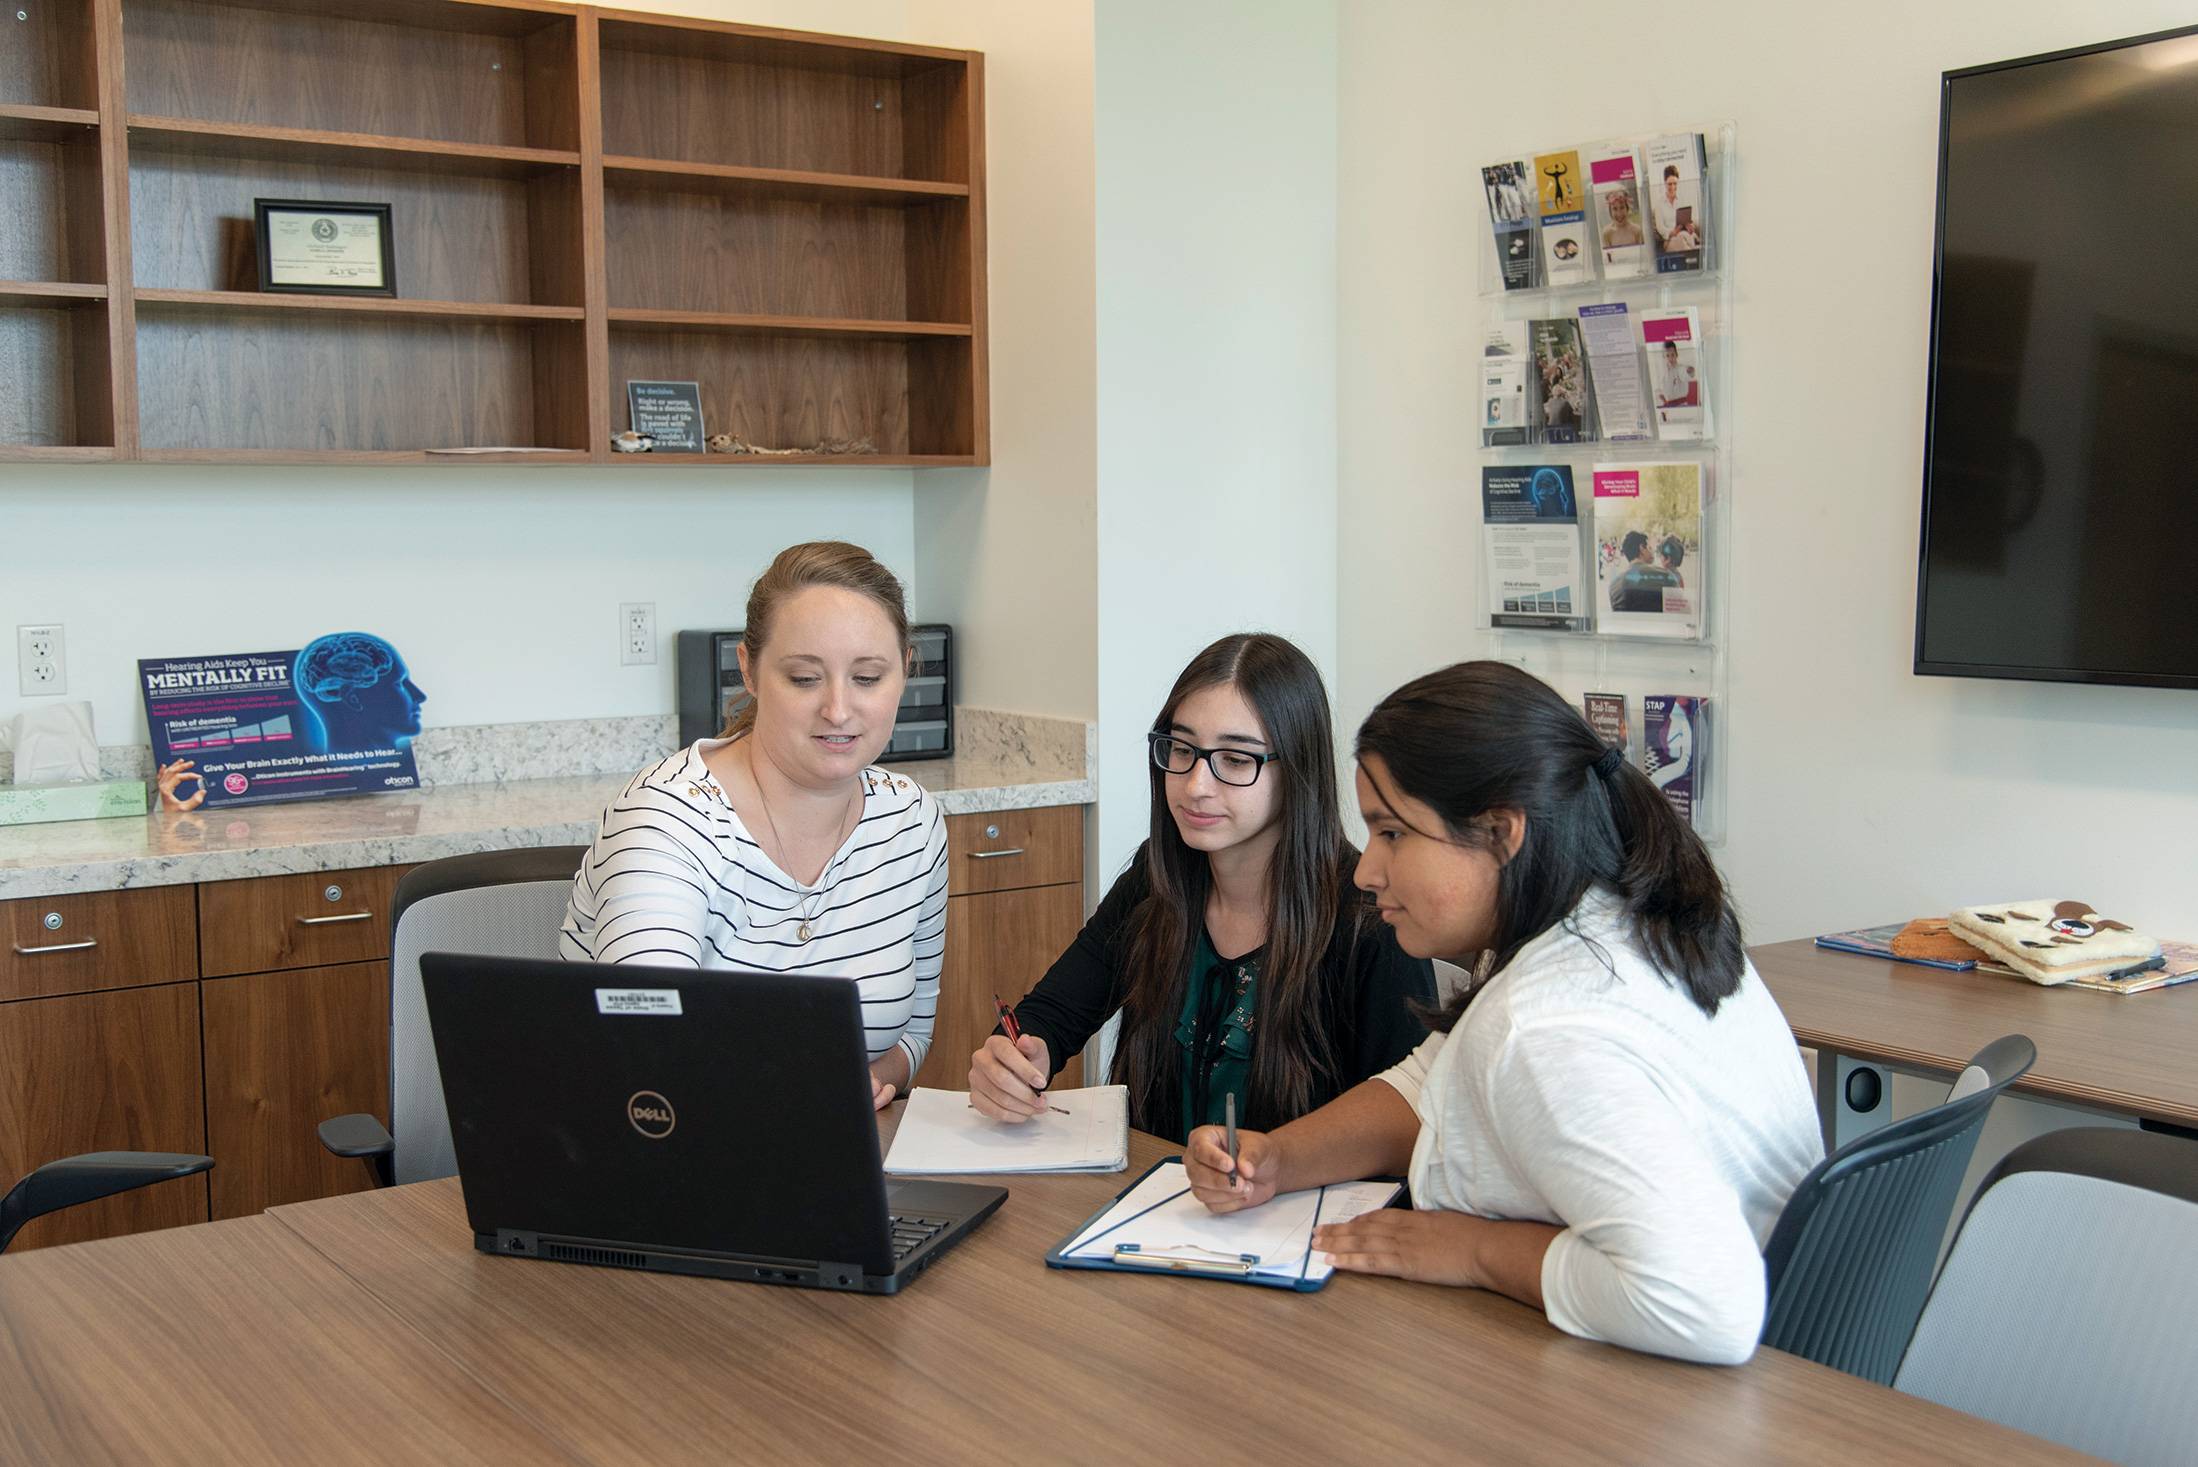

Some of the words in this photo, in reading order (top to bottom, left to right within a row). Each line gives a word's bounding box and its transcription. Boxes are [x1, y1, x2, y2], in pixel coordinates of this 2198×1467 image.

[165, 662, 203, 672] Hearing
[204, 660, 224, 669] Aids
[225, 658, 249, 669] Keep
[249, 657, 267, 666] You
[146, 668, 252, 689] MENTALLY
[255, 665, 287, 681] FIT
[1646, 701, 1665, 710] STAP
[170, 720, 188, 728] Risk
[188, 719, 197, 727] of
[198, 716, 237, 726] dementia
[203, 764, 224, 772] Give
[224, 762, 245, 770] Your
[246, 759, 271, 769] Brain
[271, 756, 304, 766] Exactly
[304, 754, 328, 763] What
[337, 751, 364, 760] Needs
[364, 750, 374, 758] to
[384, 775, 414, 785] oticon
[633, 1107, 670, 1122] DELL
